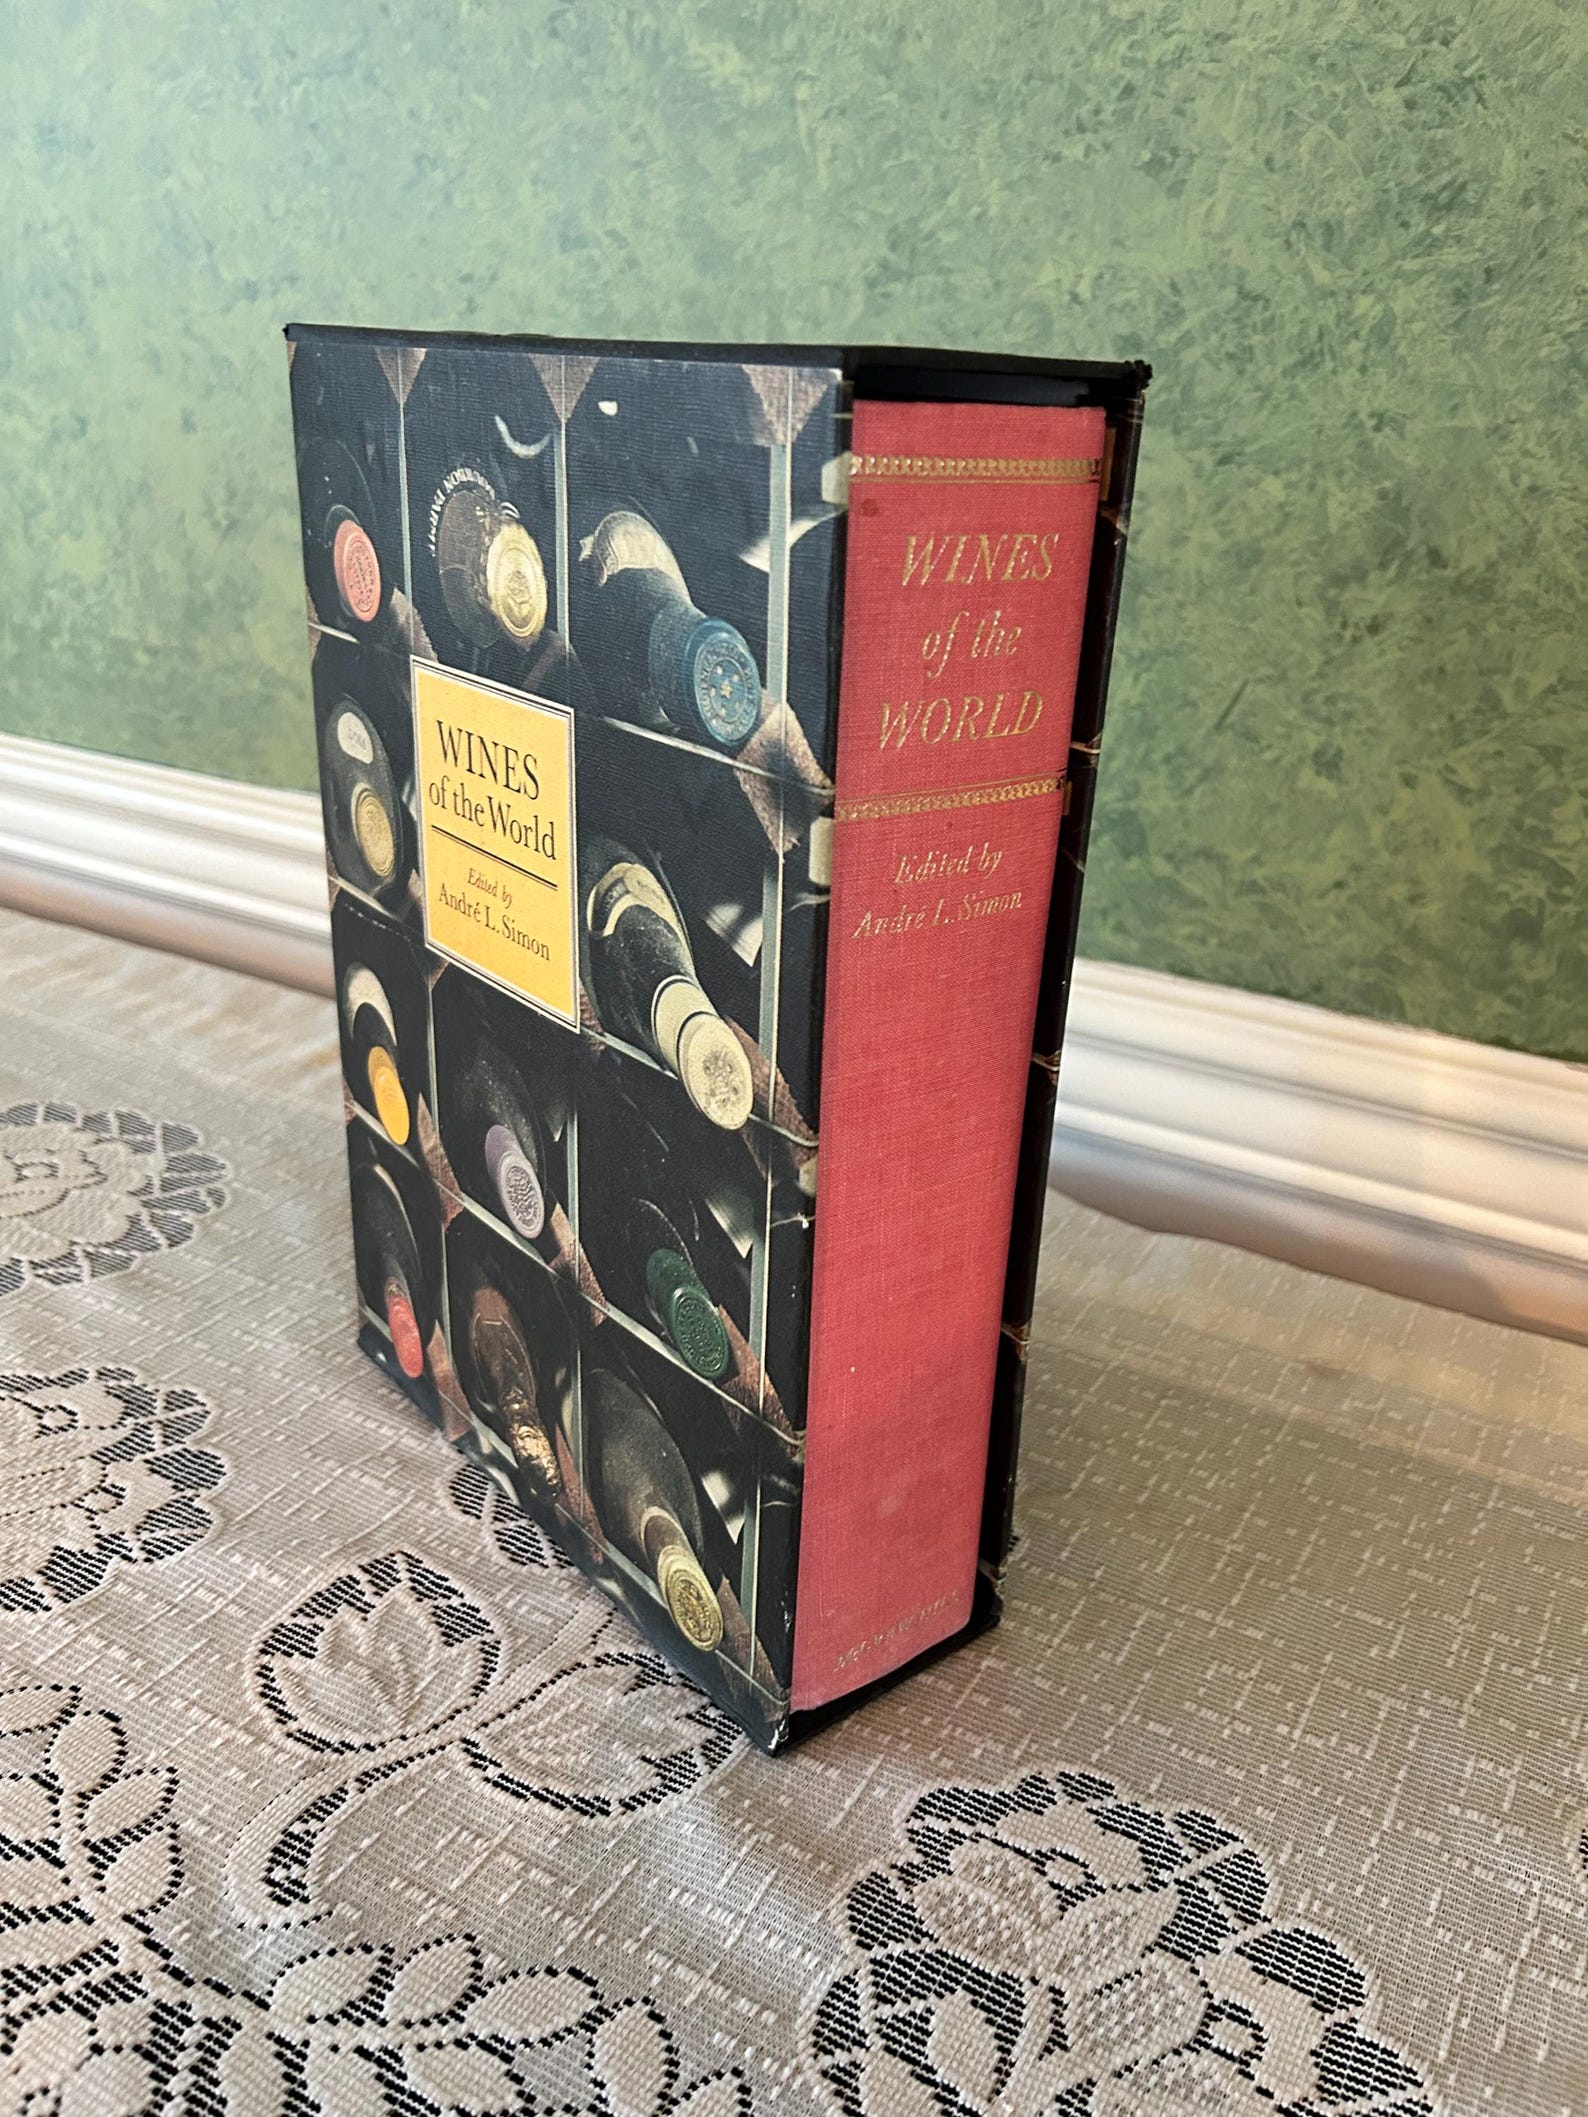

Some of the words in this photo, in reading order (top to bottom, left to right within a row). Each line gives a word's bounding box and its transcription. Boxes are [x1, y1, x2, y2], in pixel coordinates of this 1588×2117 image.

[902, 533, 1059, 586] WINES
[921, 610, 970, 679] of
[971, 609, 1022, 659] the
[880, 691, 1044, 750] WORLD
[436, 719, 539, 800] WINES
[429, 774, 451, 810] of
[453, 782, 485, 827] the
[487, 795, 557, 861] World
[467, 867, 498, 898] Edited
[502, 884, 513, 910] by
[894, 845, 974, 884] Edited
[977, 841, 1003, 880] by
[438, 882, 481, 923] André
[484, 905, 500, 934] L.
[502, 914, 551, 961] Simon
[852, 904, 926, 939] André
[959, 889, 1022, 921] Simon
